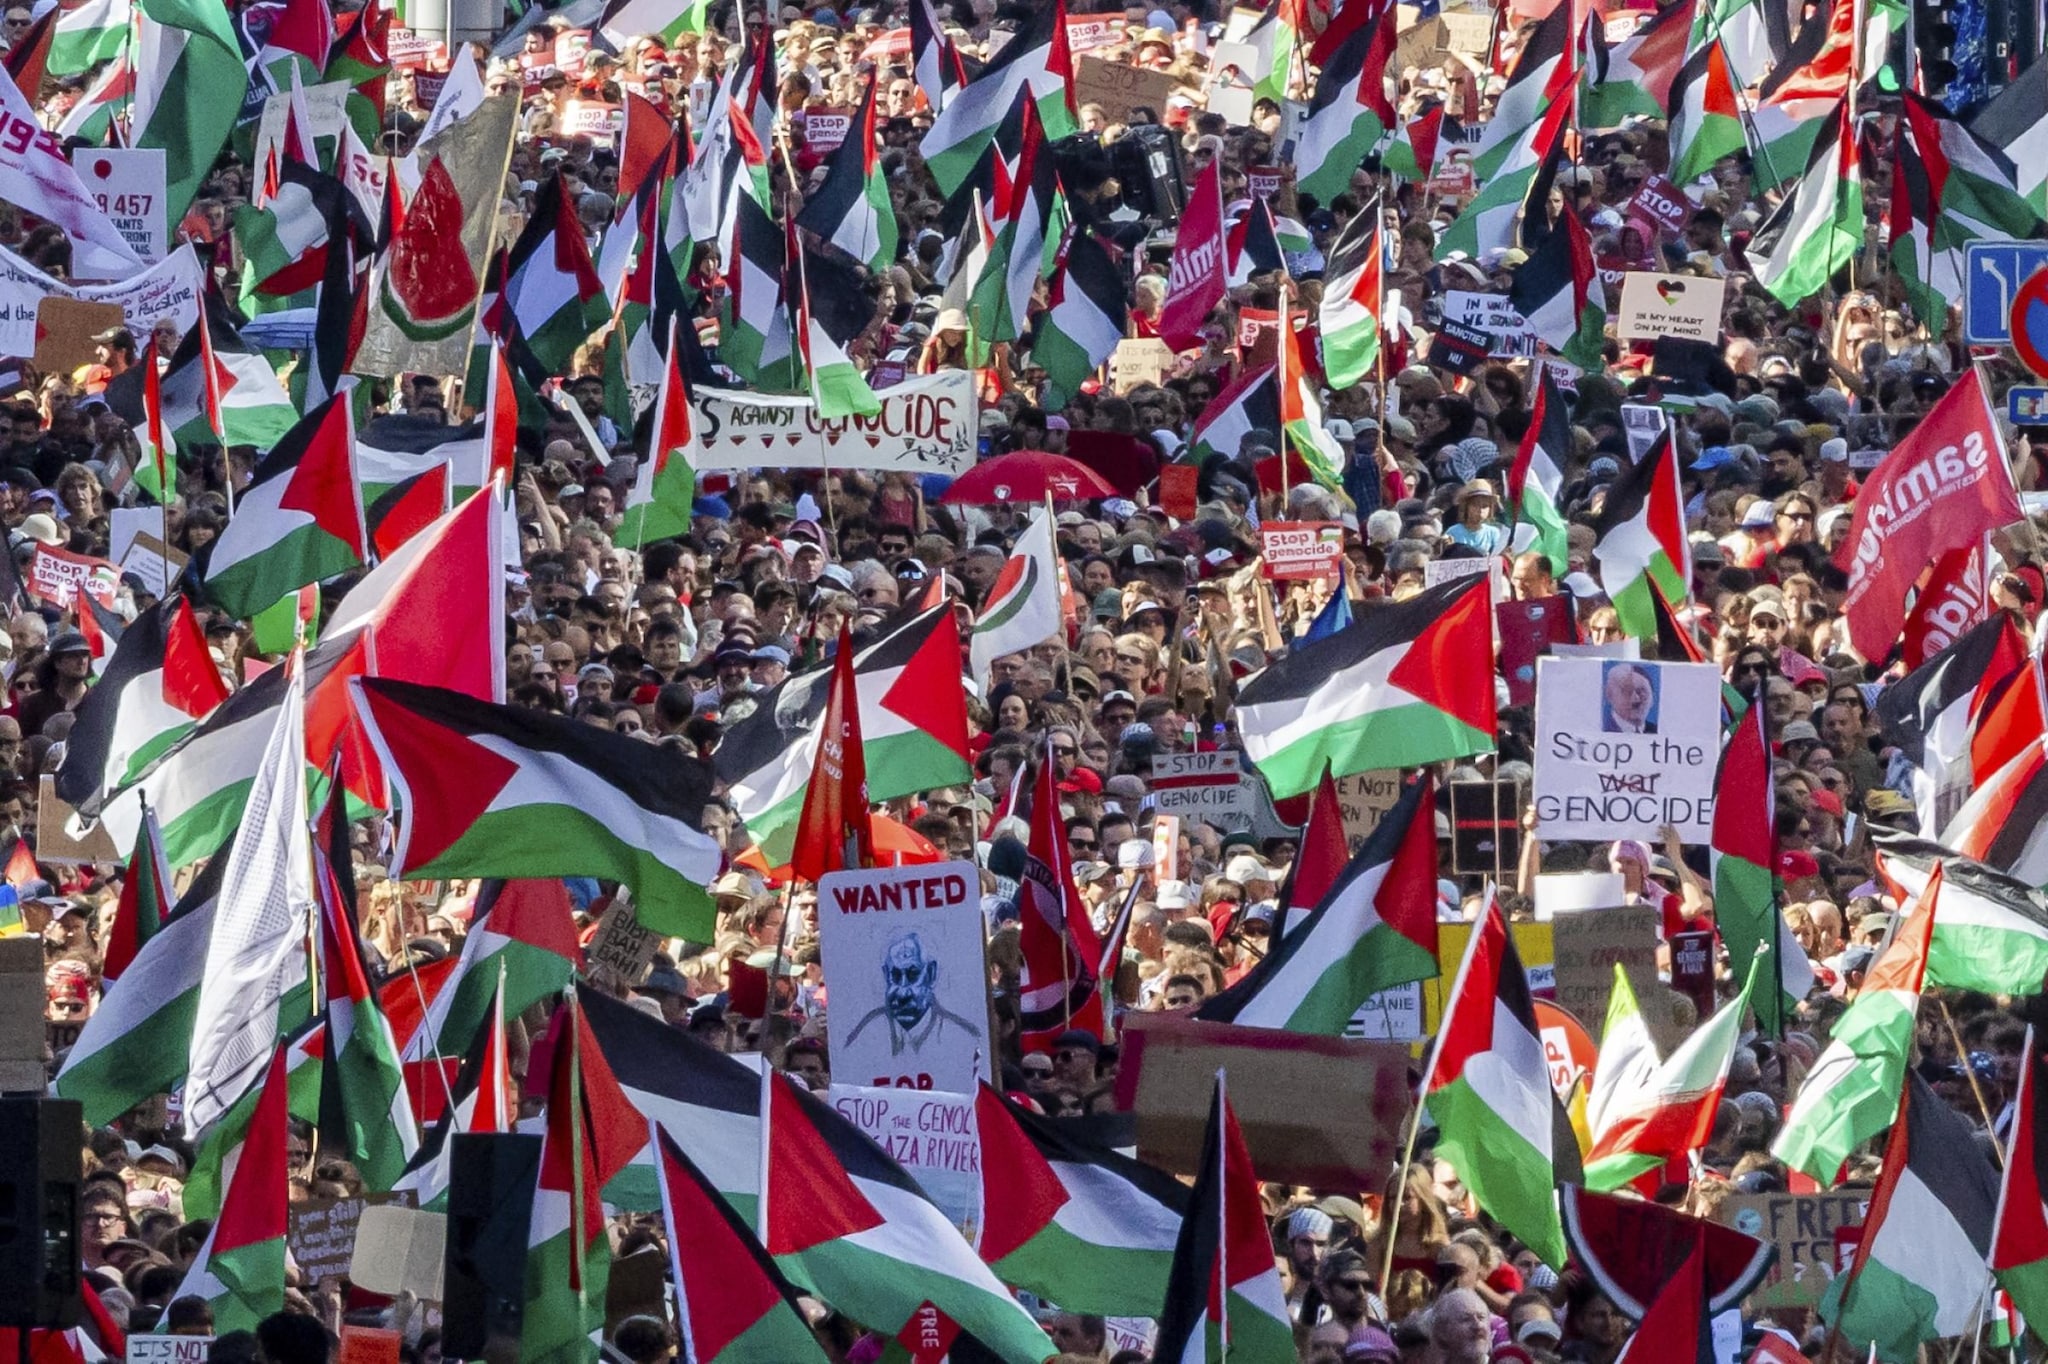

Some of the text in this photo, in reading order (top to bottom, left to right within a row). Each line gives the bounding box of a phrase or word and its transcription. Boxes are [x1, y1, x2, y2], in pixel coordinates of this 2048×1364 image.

[809, 117, 844, 129] Stop
[114, 195, 153, 216] 457
[1639, 188, 1684, 218] STOP
[16, 304, 35, 321] the
[1466, 298, 1480, 310] IN
[1634, 322, 1702, 336] ON MY MIND
[1636, 312, 1704, 326] IN MY HEART
[1444, 323, 1488, 347] SANCTIES
[1447, 352, 1463, 366] NU
[1269, 532, 1309, 547] Stop
[1268, 543, 1334, 560] genocide
[42, 557, 83, 575] Stop
[38, 568, 106, 592] genocide
[1552, 731, 1704, 769] Stop the
[1172, 755, 1217, 773] STOP
[1358, 775, 1396, 796] NOT
[1536, 795, 1712, 825] GENOCIDE
[832, 874, 967, 915] WANTED
[836, 1097, 889, 1129] STOP
[891, 1116, 911, 1129] THE
[874, 1135, 920, 1166] AZA
[919, 1306, 940, 1349] FREE
